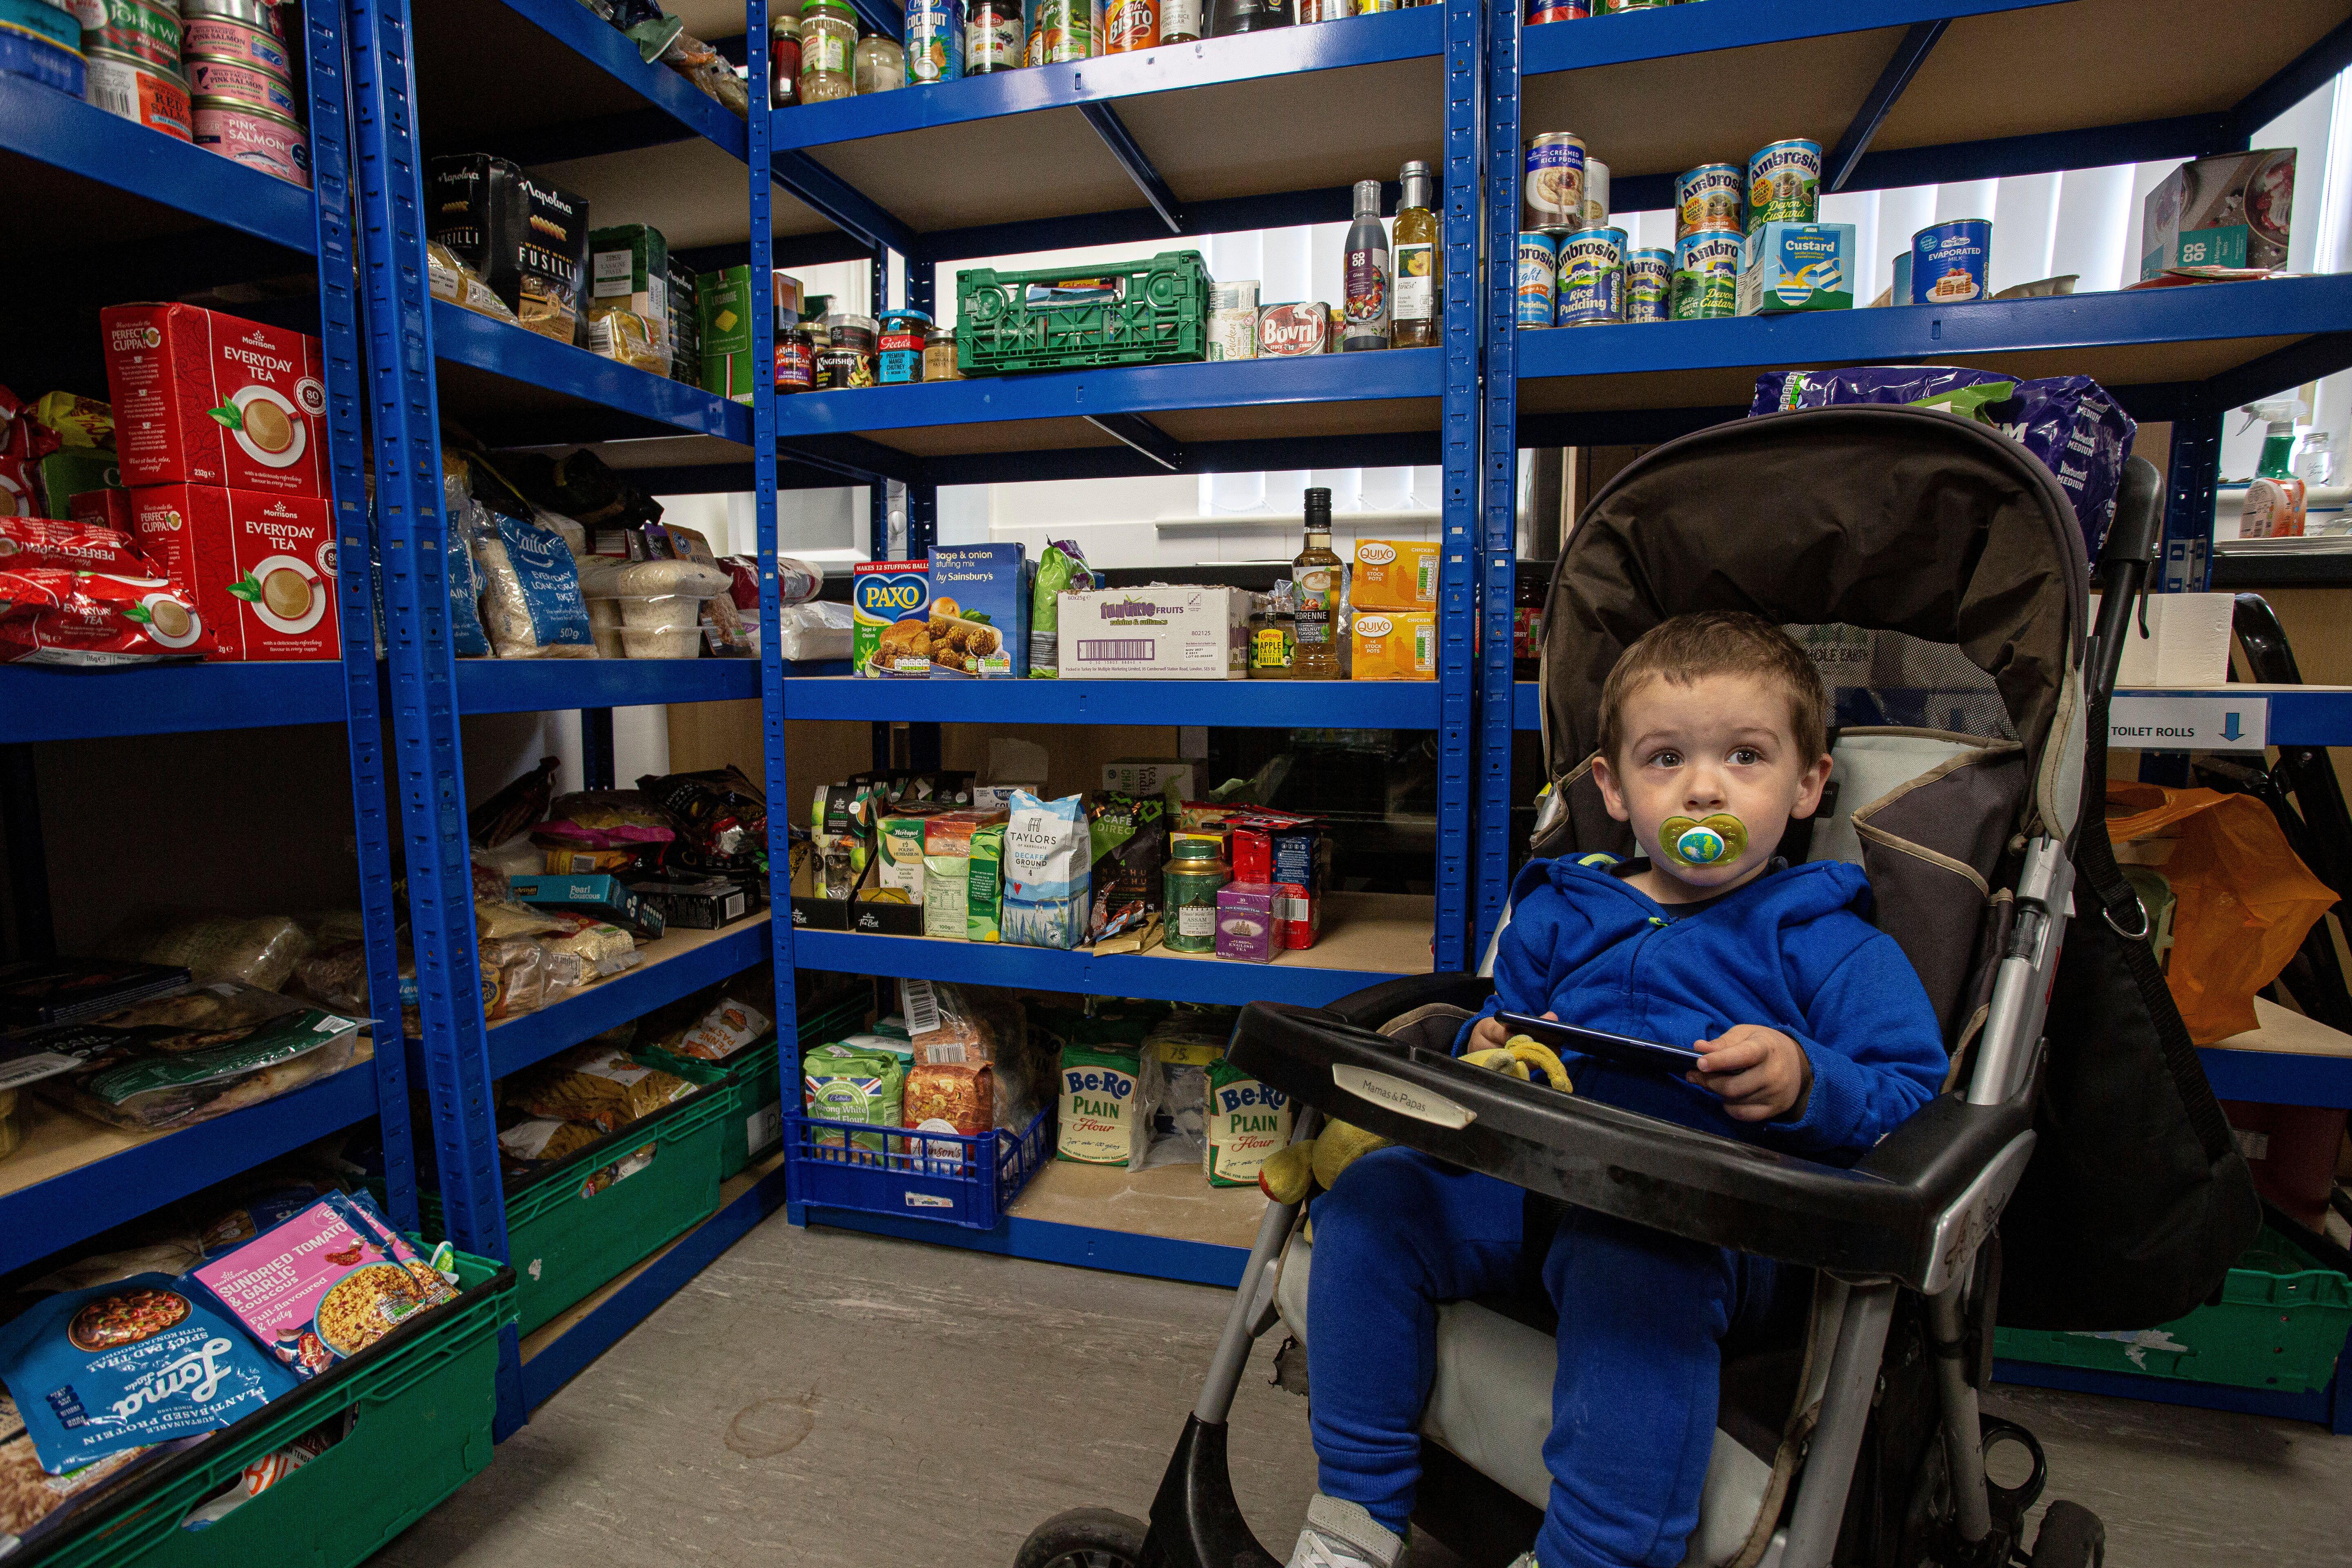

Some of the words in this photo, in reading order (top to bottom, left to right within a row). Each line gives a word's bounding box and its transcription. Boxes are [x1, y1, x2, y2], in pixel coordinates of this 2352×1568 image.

[1109, 10, 1153, 45] BISTO
[229, 119, 256, 132] PINK
[229, 129, 285, 150] SALMON
[1550, 149, 1579, 158] CREAMED
[1558, 157, 1584, 167] PUDDING
[1751, 151, 1819, 183] Ambrosia
[1753, 180, 1766, 192] WIN
[518, 180, 572, 215] Napolina
[1685, 199, 1700, 211] WIN
[1768, 200, 1801, 212] Devon
[1762, 207, 1805, 223] Custard
[1785, 240, 1835, 252] Custard
[1928, 247, 1981, 261] EVAPORATED
[519, 246, 577, 283] FUSILLI
[1570, 288, 1595, 301] Rice
[1682, 296, 1695, 305] WEST
[1706, 288, 1735, 300] Devon
[1560, 298, 1607, 317] Pudding
[1679, 302, 1699, 313] COUNTRY
[112, 328, 145, 341] PERFECT
[1264, 315, 1318, 344] Bovril
[113, 337, 147, 352] CUPPA!
[242, 335, 276, 351] Morrisons
[881, 338, 911, 350] Geeta's
[1225, 323, 1237, 357] Chicken
[224, 345, 293, 374] EVERYDAY
[247, 365, 276, 383] TEA
[306, 390, 319, 401] 80
[2076, 405, 2101, 423] MEDIUM
[2067, 440, 2094, 458] MEDIUM
[194, 468, 209, 479] 232g
[2056, 474, 2084, 492] MEDIUM
[140, 511, 168, 523] PERFECT
[264, 509, 298, 519] Morrisons
[142, 521, 169, 533] CUPPA!
[245, 521, 316, 539] EVERYDAY
[269, 536, 297, 551] TEA
[935, 552, 958, 562] sage
[968, 550, 993, 559] onion
[1360, 548, 1394, 560] QUIXO
[936, 560, 961, 569] stuffing
[935, 572, 948, 584] by
[948, 572, 993, 582] Sainsbury's
[555, 592, 576, 603] RICE
[865, 586, 920, 610] PAXO
[1100, 599, 1156, 620] funtime
[1156, 606, 1184, 614] FRUITS
[84, 615, 103, 625] TEA
[1357, 621, 1390, 633] QUIXO
[1261, 632, 1281, 640] Colman's
[2111, 727, 2153, 737] TOILET
[2156, 727, 2194, 738] ROLLS
[1121, 769, 1131, 791] CHAI
[893, 829, 918, 837] Herbapol
[1097, 823, 1138, 835] DIRECT
[1010, 832, 1057, 845] TAYLORS
[1016, 859, 1047, 867] GROUND
[571, 885, 591, 895] Pearl
[698, 1031, 730, 1055] PENNE
[1362, 1080, 1391, 1099] Mamas
[1392, 1092, 1398, 1102] &
[1399, 1093, 1426, 1112] Papas
[817, 1104, 840, 1114] Strong
[842, 1105, 866, 1114] White
[1073, 1096, 1119, 1119] PLAIN
[1072, 1117, 1115, 1133] Flour
[1230, 1114, 1278, 1133] PLAIN
[1232, 1136, 1274, 1153] Flour
[323, 1211, 339, 1223] 5
[218, 1252, 295, 1298] SUNDRIED
[292, 1221, 349, 1257] TOMATO
[212, 1268, 248, 1289] Morrisons
[229, 1294, 244, 1308] &
[243, 1266, 298, 1301] GARLIC
[238, 1276, 299, 1314] COUSCOUS
[249, 1277, 328, 1325] Full-flavoured
[257, 1322, 267, 1334] &
[265, 1309, 294, 1327] tasty
[179, 1327, 206, 1336] WITH
[137, 1333, 177, 1349] KONJAC
[85, 1345, 135, 1370] NOODLES
[133, 1345, 165, 1360] PAD
[89, 1353, 133, 1373] THAI
[111, 1337, 232, 1417] Loma
[123, 1372, 155, 1392] Linda
[82, 1416, 159, 1446] PROTEIN
[145, 1415, 215, 1434] SUSTAINABLE
